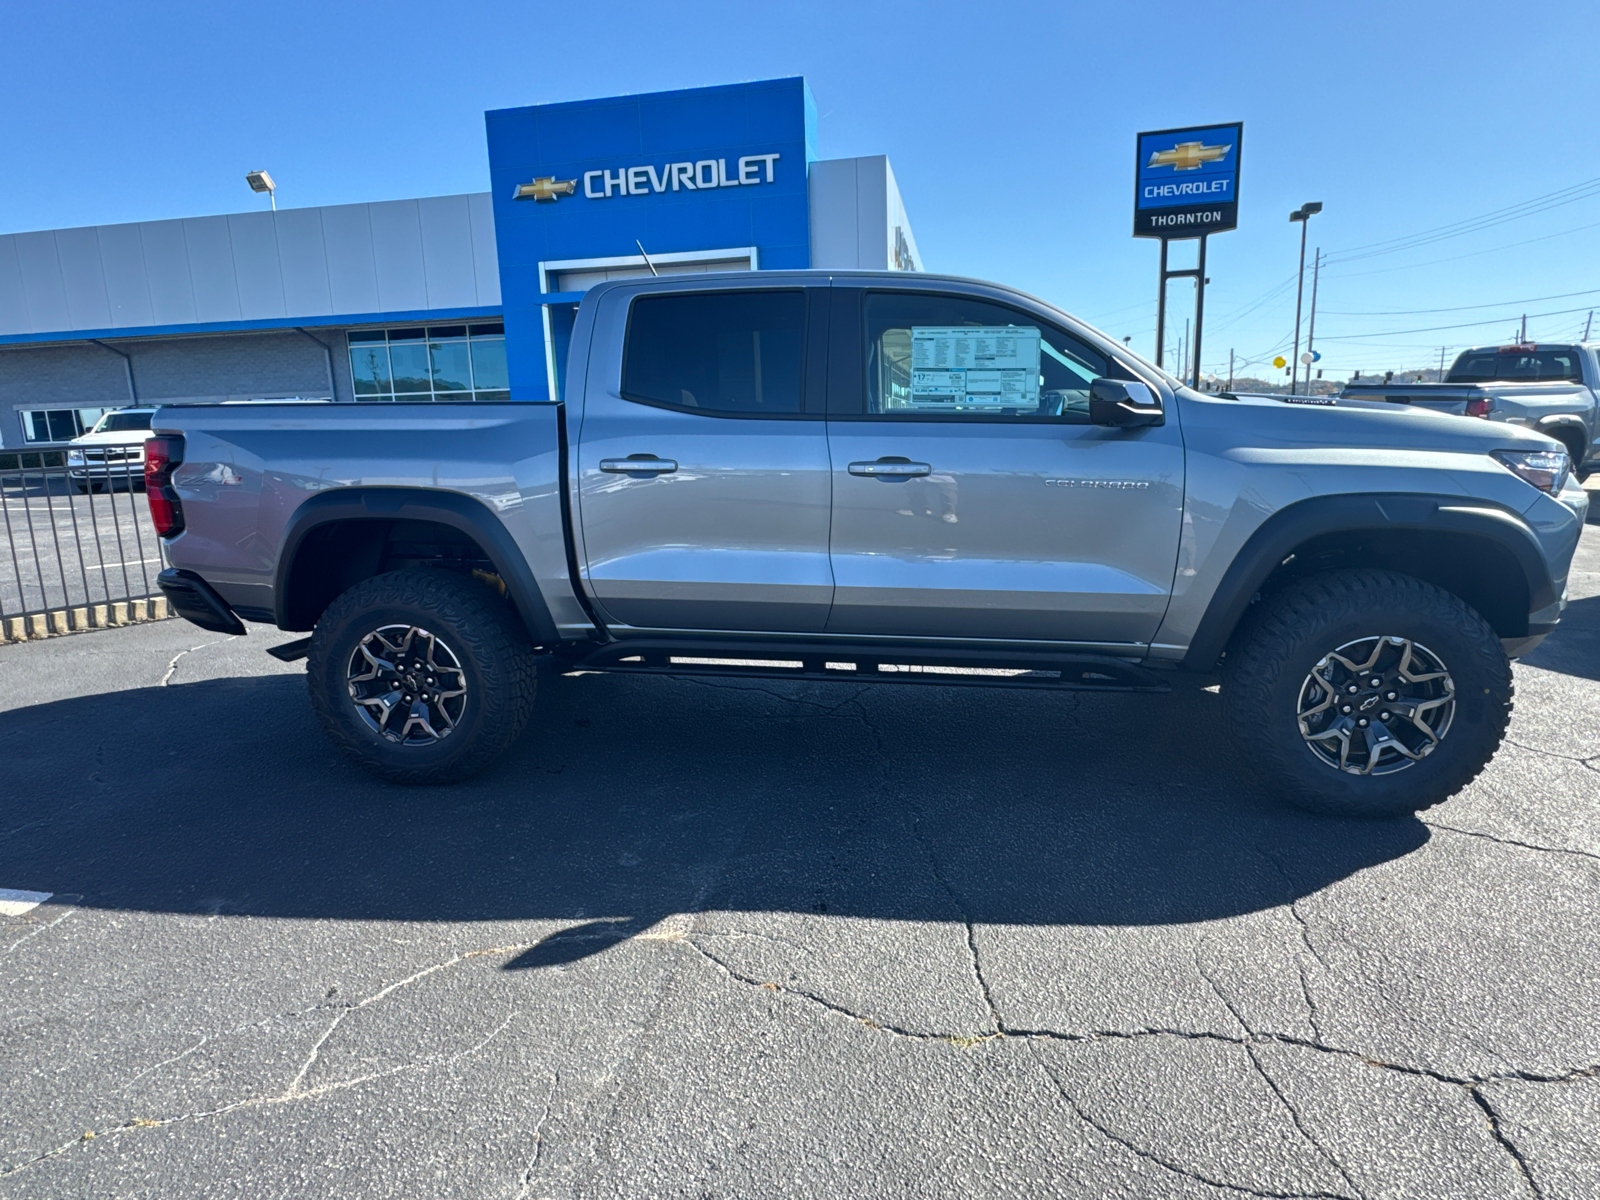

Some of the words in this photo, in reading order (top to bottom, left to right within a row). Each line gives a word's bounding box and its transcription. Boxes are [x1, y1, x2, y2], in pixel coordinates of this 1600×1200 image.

[583, 153, 780, 199] CHEVROLET
[1144, 179, 1230, 198] CHEVROLET
[1150, 211, 1222, 227] THORNTON
